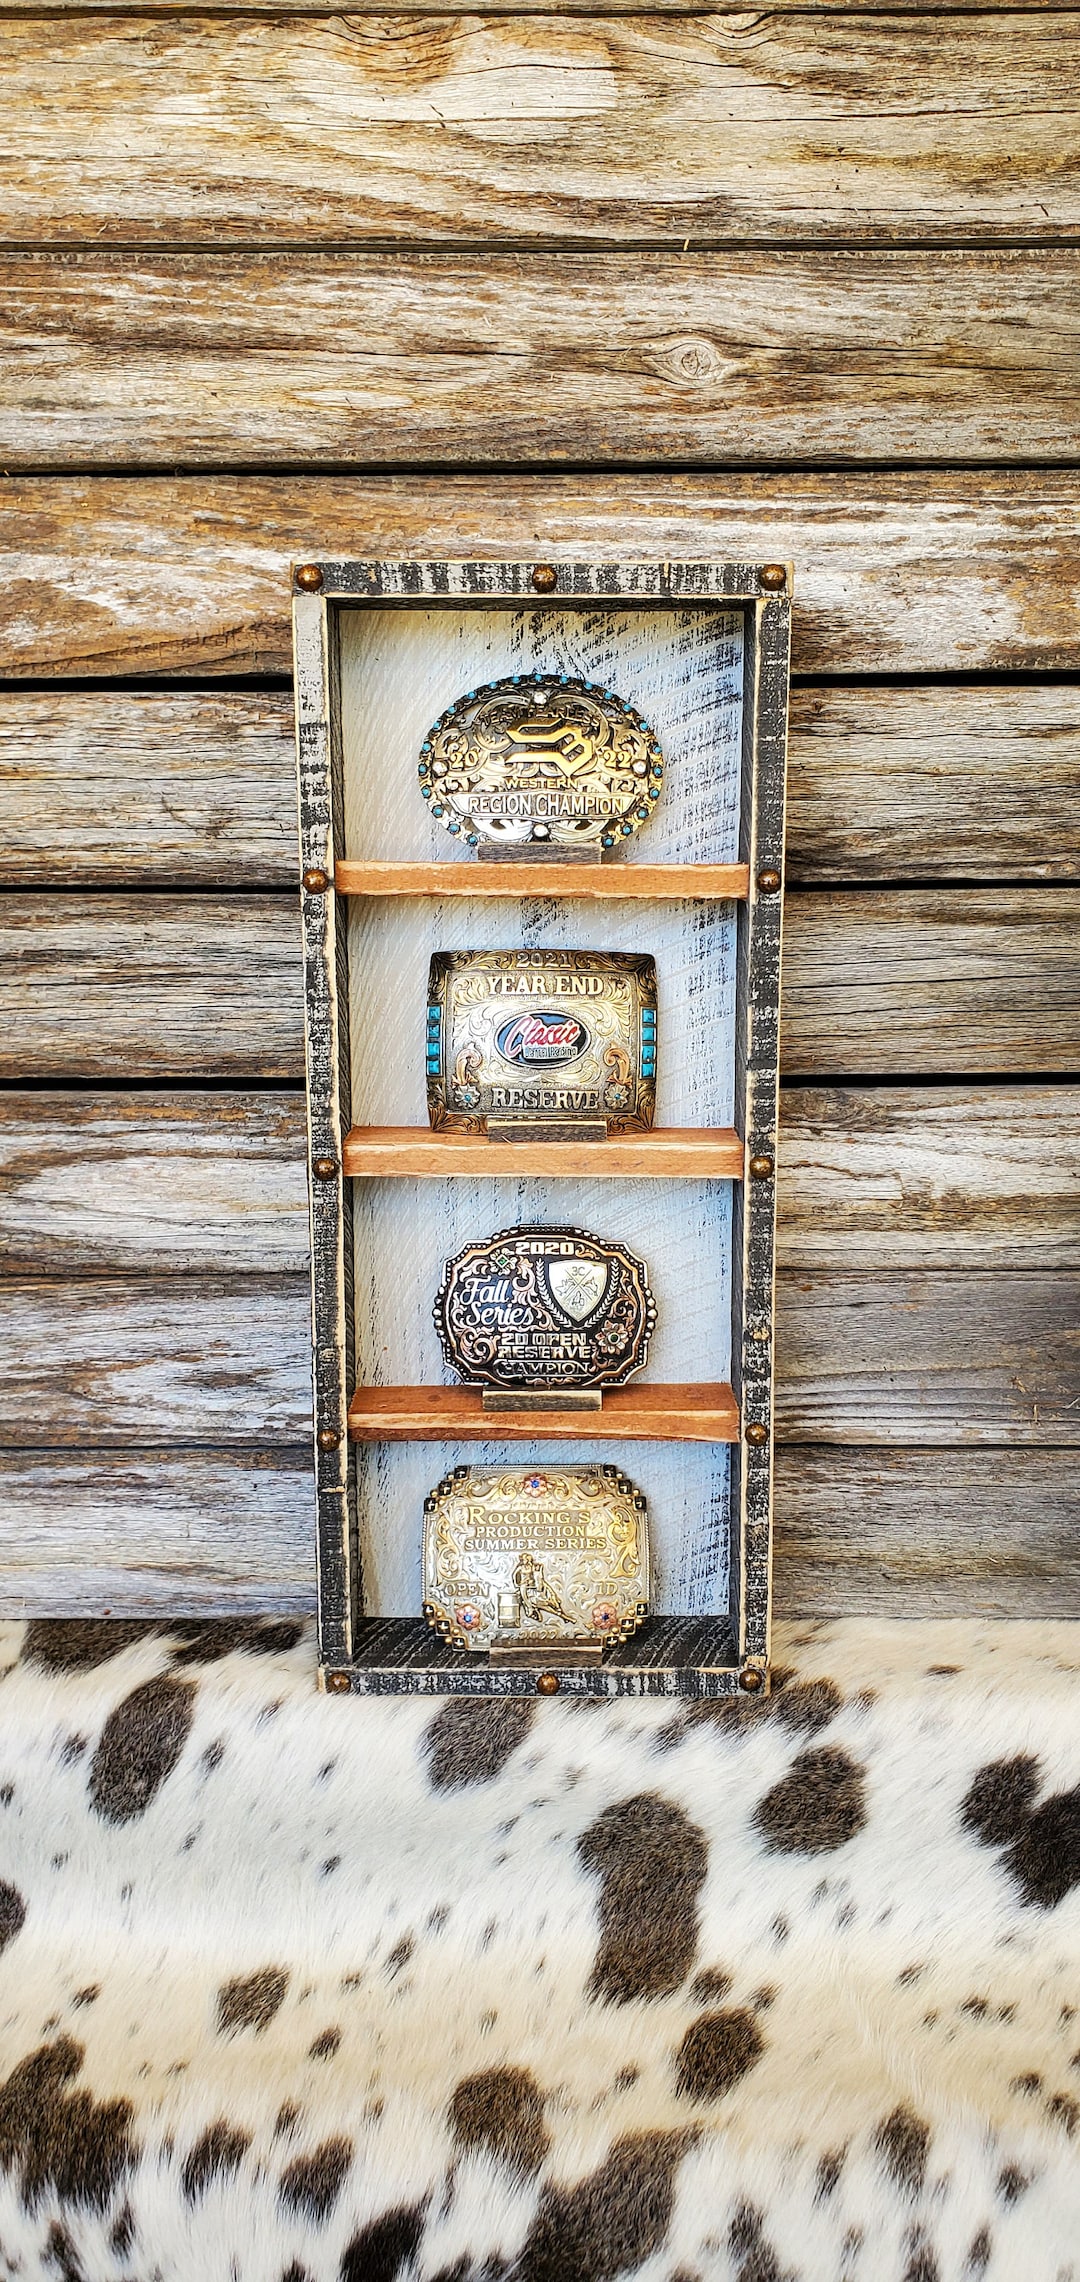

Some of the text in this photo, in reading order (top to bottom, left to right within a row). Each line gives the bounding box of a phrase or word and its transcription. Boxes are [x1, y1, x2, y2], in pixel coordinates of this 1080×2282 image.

[450, 750, 479, 769] 20
[603, 750, 632, 769] 22
[505, 778, 579, 789] WESTERN
[468, 795, 622, 815] REGION CHAMPION
[516, 953, 571, 968] 2021
[489, 975, 604, 996] YEAR END
[504, 1015, 581, 1058] Classic
[491, 1087, 599, 1110] RESERVE
[515, 1241, 576, 1256] 2020
[571, 1266, 585, 1277] 3C
[460, 1275, 509, 1305] Fall
[466, 1303, 534, 1326] Series
[532, 1332, 587, 1346] OPEN
[497, 1346, 592, 1359] RESERVE
[494, 1360, 591, 1376] CHAMPION
[468, 1505, 571, 1525] ROCKING
[476, 1526, 585, 1538] PRODUCTION
[465, 1538, 607, 1550] SUMMER SERIES
[445, 1583, 491, 1596] OPEN
